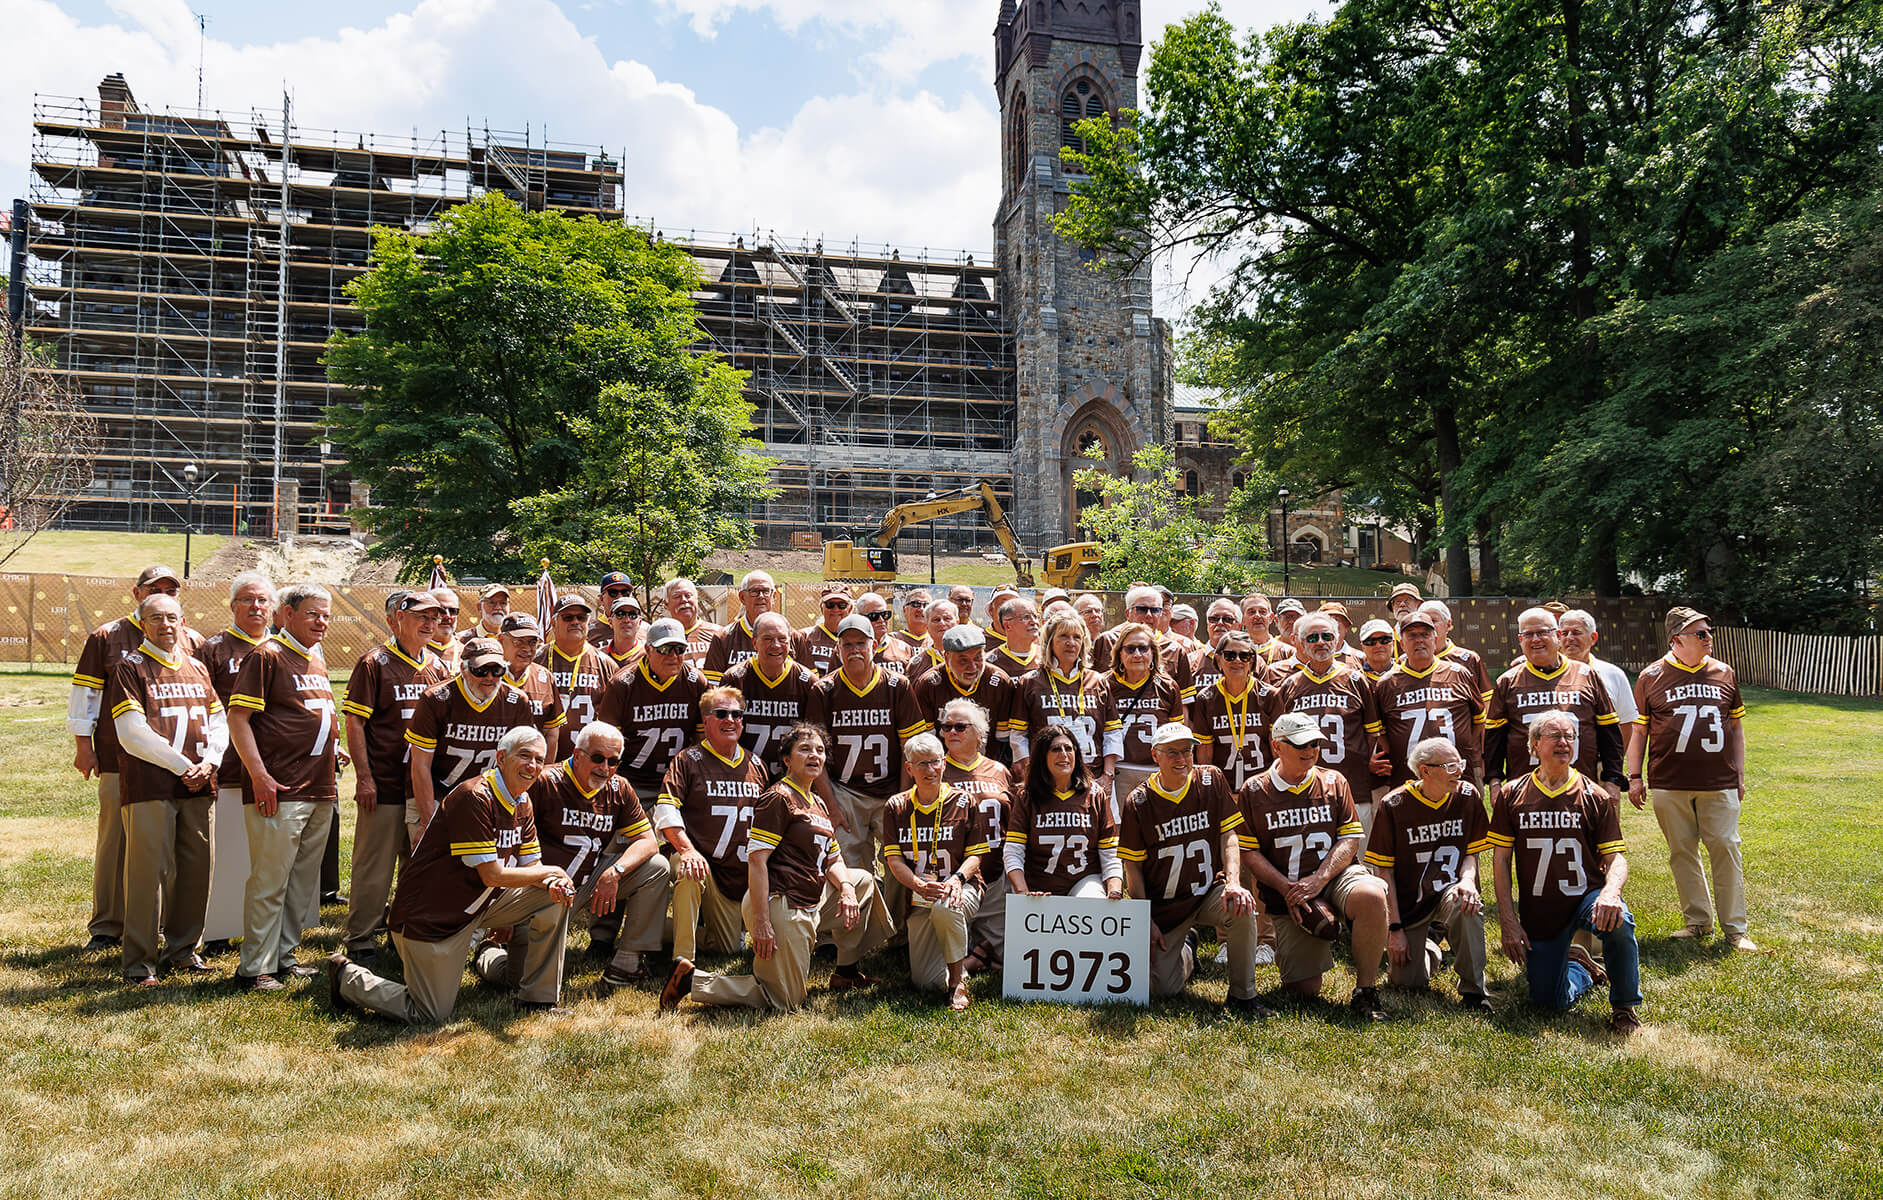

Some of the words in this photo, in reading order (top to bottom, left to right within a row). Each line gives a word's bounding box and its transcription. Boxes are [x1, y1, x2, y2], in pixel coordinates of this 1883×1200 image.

[869, 550, 882, 559] CAT
[150, 682, 208, 700] LEHIGH
[393, 683, 428, 701] LEH
[1396, 687, 1453, 708] LEHIGH
[1517, 690, 1582, 708] LEHIGH
[1665, 683, 1723, 702] LEHIGH
[744, 700, 799, 718] LEHIGH
[1040, 694, 1098, 710] LEHIGH
[1293, 695, 1348, 712] LEHIGH
[633, 703, 689, 723] LEHIGH
[832, 709, 892, 728] LEHIGH
[1213, 713, 1263, 730] LEHIGH
[160, 705, 210, 758] 73
[445, 723, 508, 742] LEHIGH
[1400, 707, 1457, 760] 73
[1672, 704, 1725, 753] 73
[629, 727, 685, 774] 73
[837, 734, 889, 785] 73
[1218, 733, 1266, 772] 73
[706, 780, 760, 798] LEHIGH
[1035, 812, 1093, 829] LEHIGH
[1155, 810, 1211, 842] LEHIGH
[1264, 804, 1334, 831] LEHIGH
[1519, 811, 1582, 830] LEHIGH
[898, 826, 954, 844] LEHIGH
[1407, 818, 1464, 845] LEHGH
[1038, 834, 1090, 876] 73
[1157, 838, 1214, 900] 73
[1415, 845, 1461, 904] 73
[1526, 837, 1588, 897] 73
[1024, 913, 1093, 935] CLASS
[1101, 916, 1132, 937] OF
[1022, 948, 1132, 994] 1973
